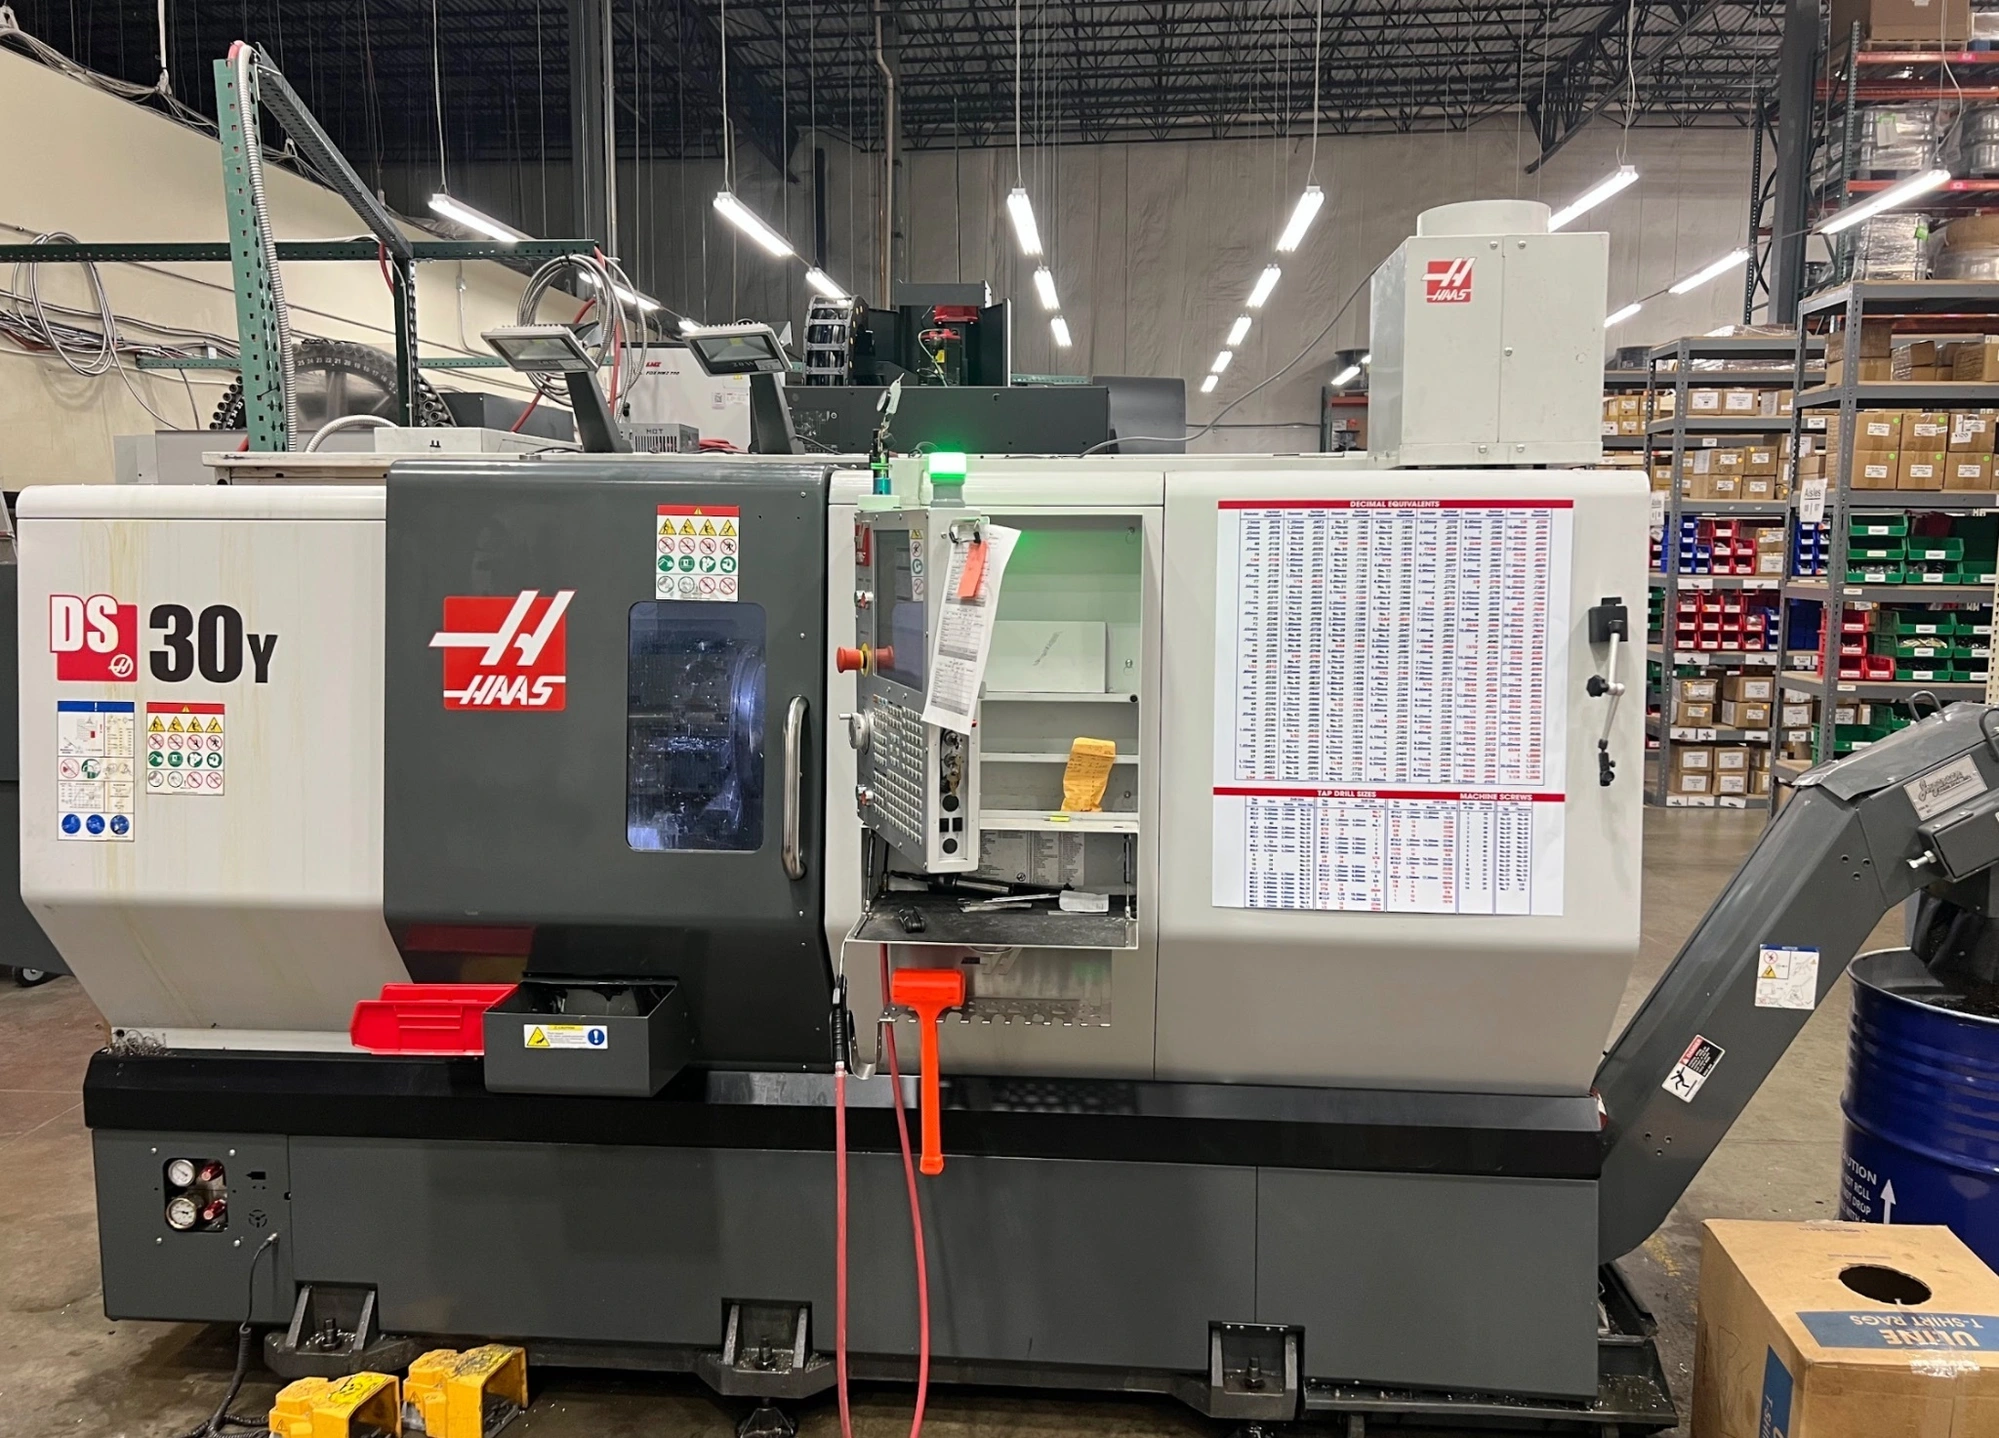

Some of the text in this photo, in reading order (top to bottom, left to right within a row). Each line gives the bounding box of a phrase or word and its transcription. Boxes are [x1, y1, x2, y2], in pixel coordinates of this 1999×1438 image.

[1429, 288, 1471, 301] HAAS
[50, 594, 119, 653] DS
[448, 674, 563, 706] HAAS
[1842, 1150, 1876, 1186] AUTION
[1854, 1182, 1871, 1201] ROLL
[1852, 1196, 1871, 1215] DROP
[1849, 1314, 1984, 1328] T-SHIRT RAGS
[1878, 1328, 1980, 1347] ULINE
